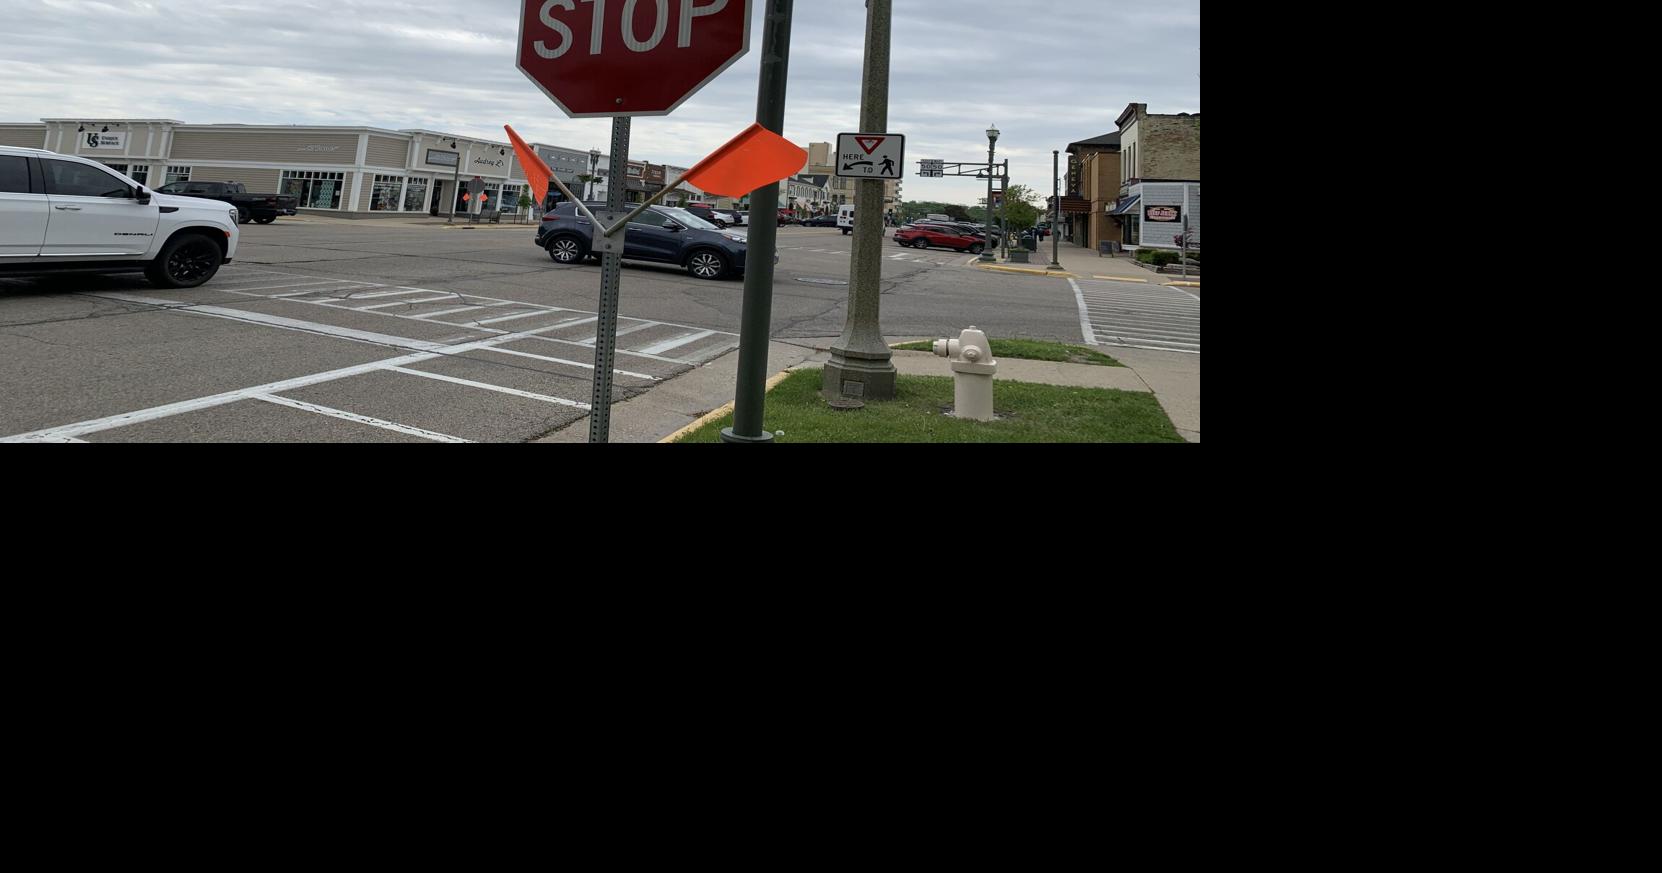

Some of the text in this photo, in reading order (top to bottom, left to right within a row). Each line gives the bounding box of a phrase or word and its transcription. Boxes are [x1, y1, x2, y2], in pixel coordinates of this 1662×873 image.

[533, 0, 728, 59] STOP
[842, 153, 865, 161] HERE
[863, 166, 874, 174] TO
